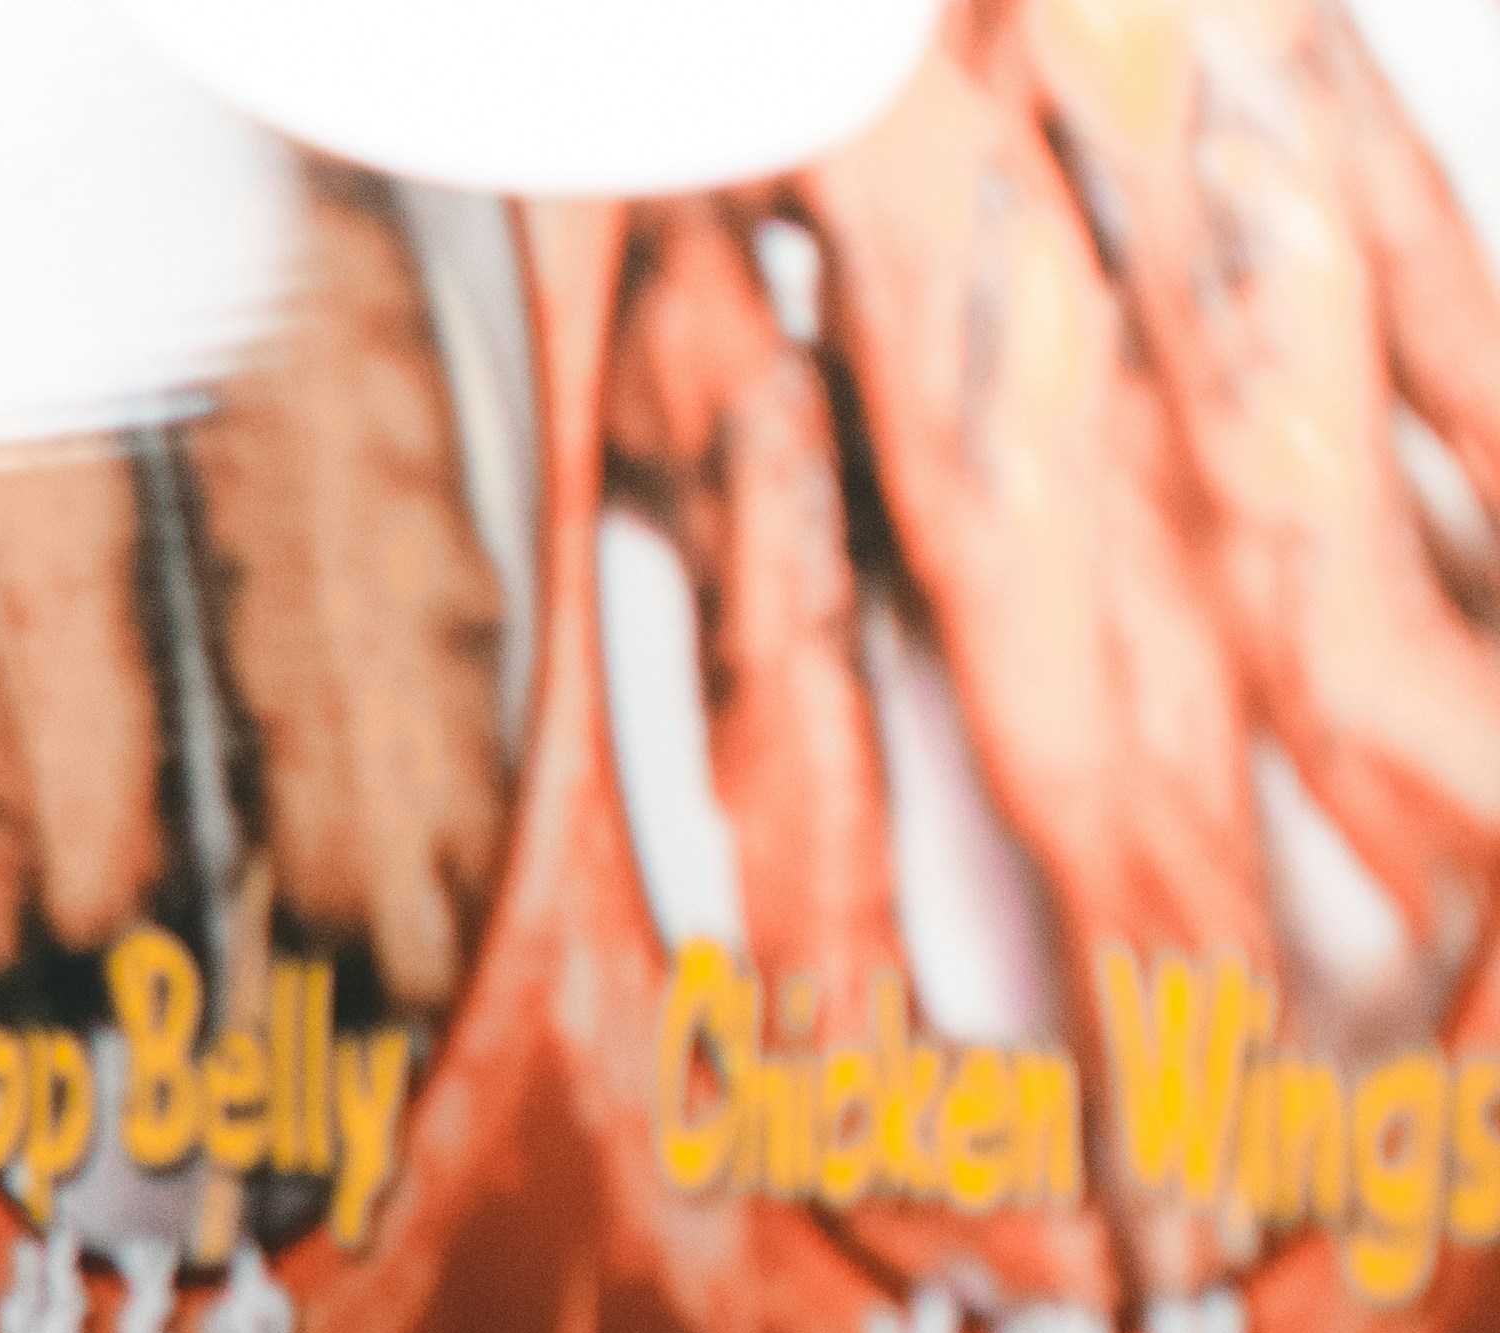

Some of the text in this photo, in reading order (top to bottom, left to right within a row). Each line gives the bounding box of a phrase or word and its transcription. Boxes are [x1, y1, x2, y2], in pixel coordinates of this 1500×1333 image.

[107, 926, 410, 1248] Belly
[655, 936, 1500, 1306] Chicken Wings
